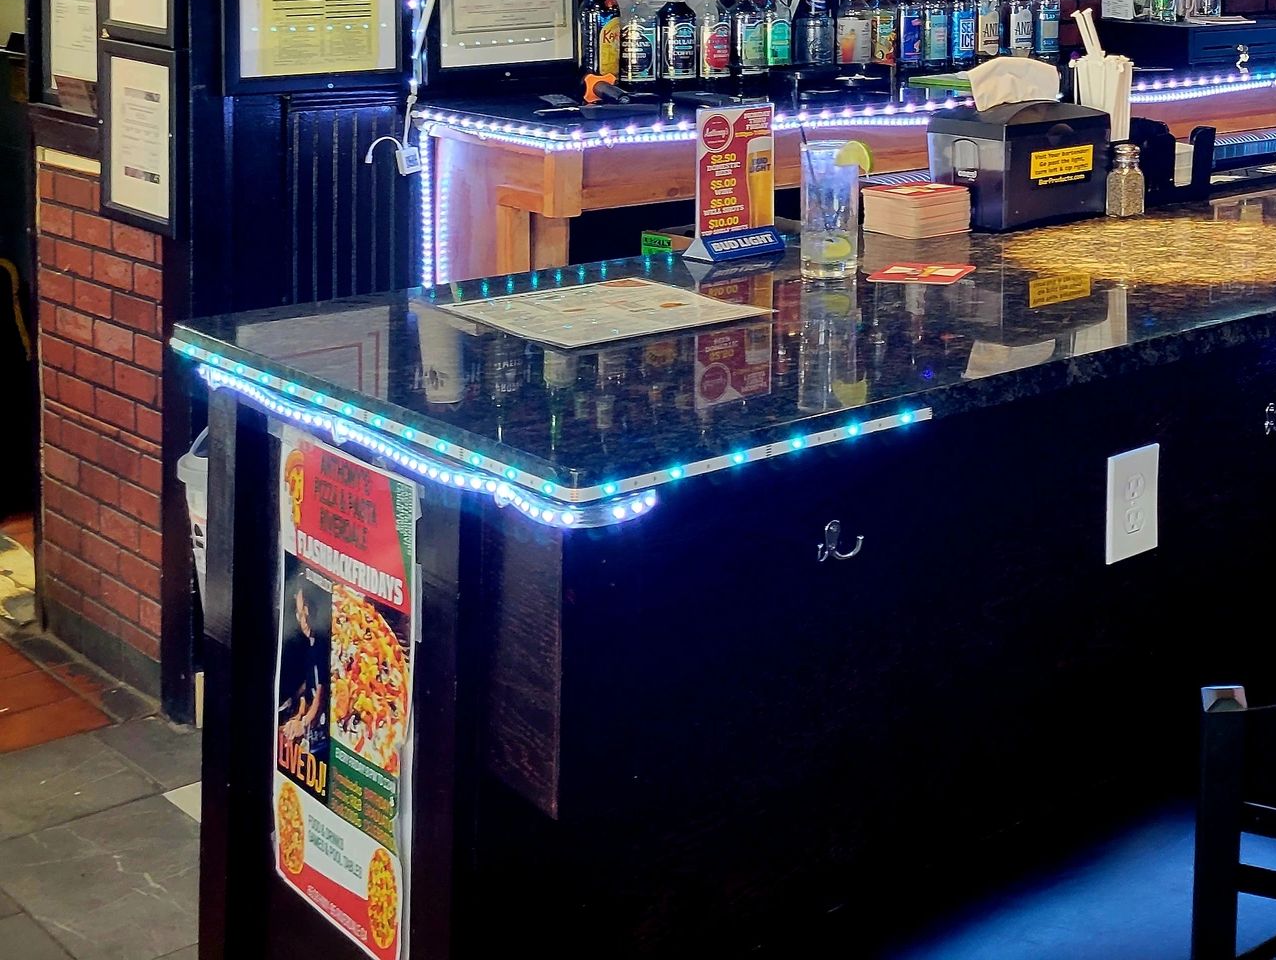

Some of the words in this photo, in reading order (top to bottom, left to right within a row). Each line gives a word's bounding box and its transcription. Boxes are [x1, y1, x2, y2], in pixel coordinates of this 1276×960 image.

[961, 33, 974, 47] ICE
[711, 152, 737, 165] $2.50
[710, 178, 737, 190] $5.00
[710, 196, 737, 209] $5.00
[708, 216, 739, 230] $10.00
[711, 240, 739, 252] BUD
[740, 233, 775, 247] LIGHT
[278, 728, 305, 782] LIVE
